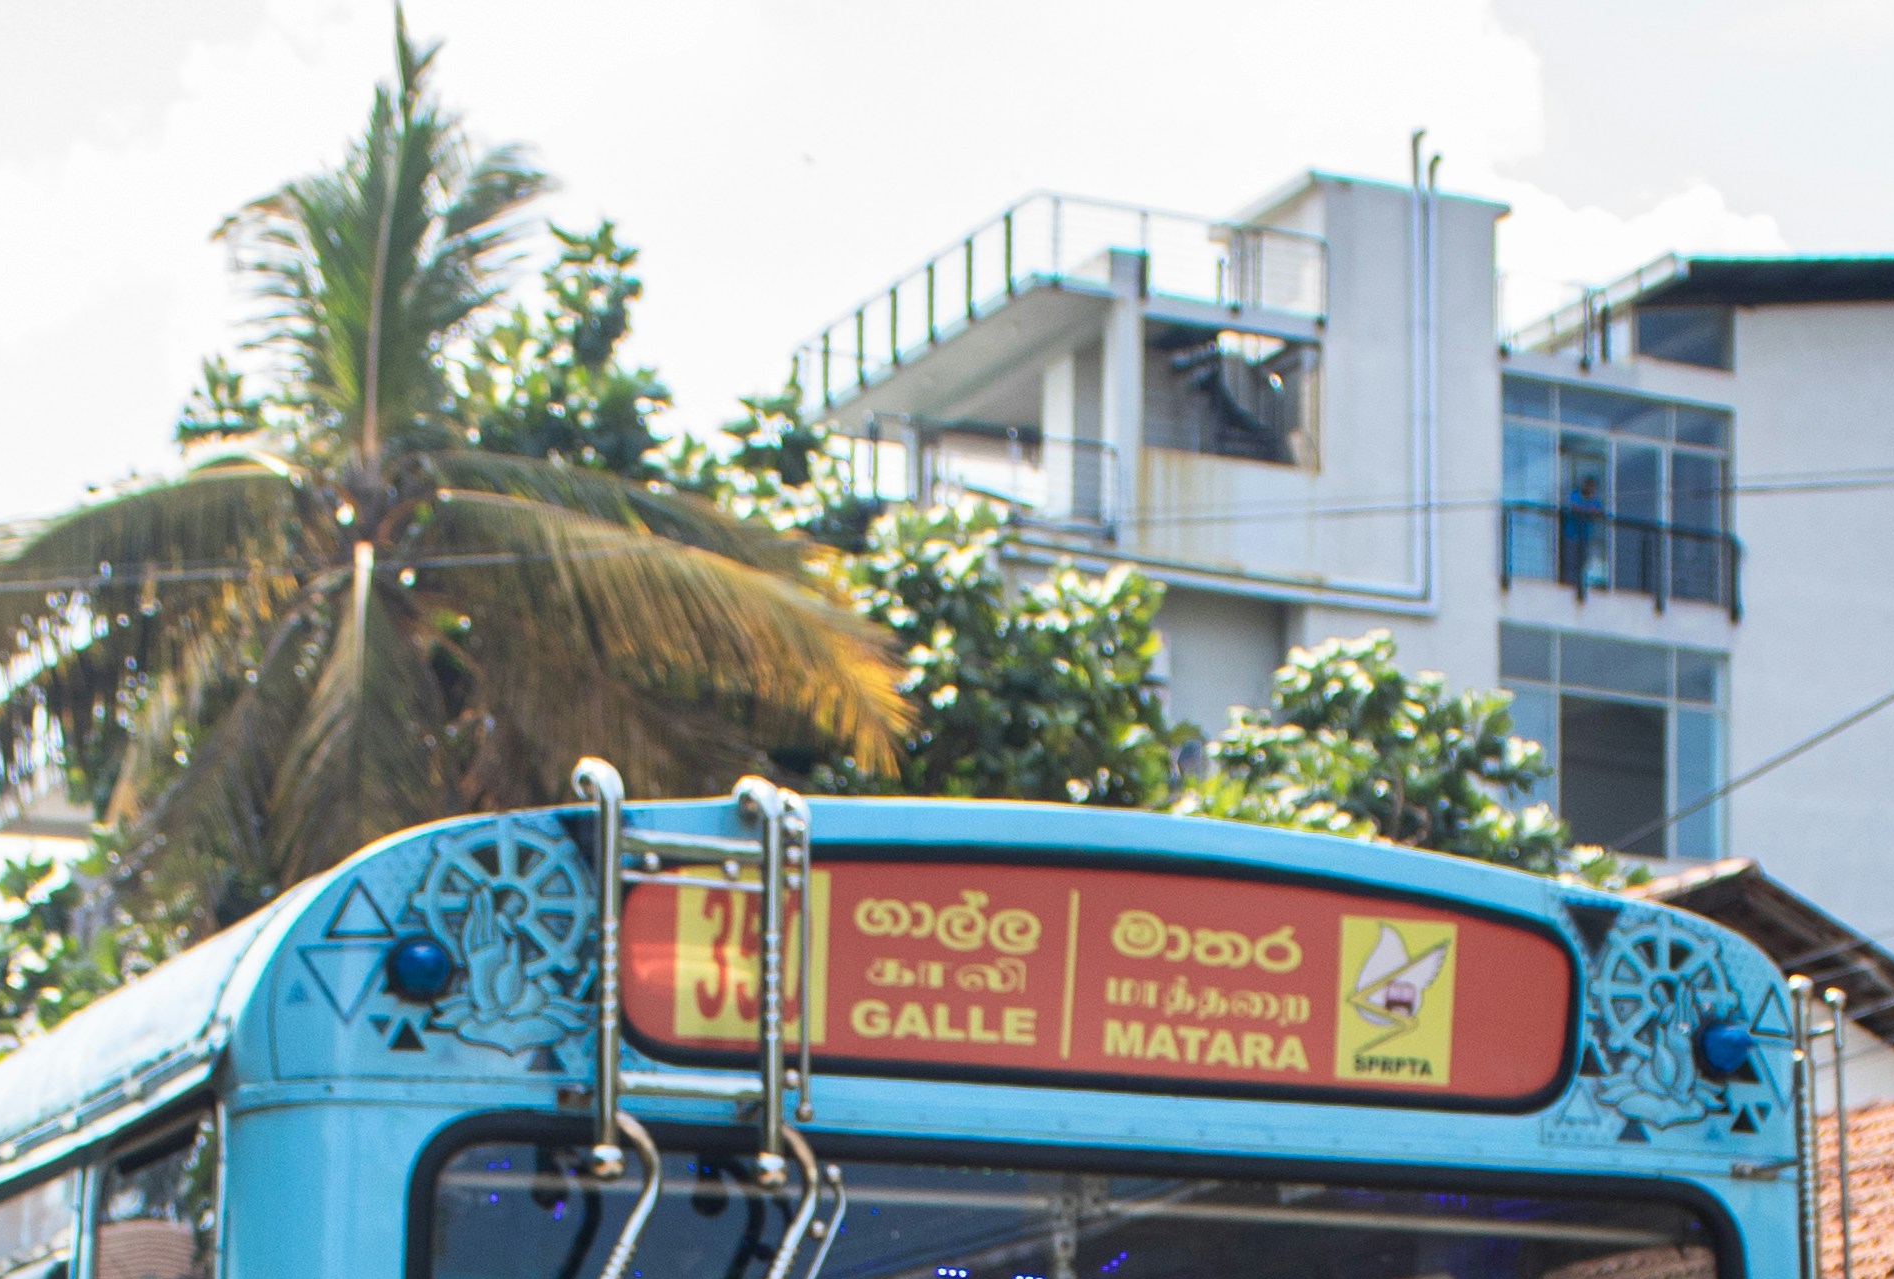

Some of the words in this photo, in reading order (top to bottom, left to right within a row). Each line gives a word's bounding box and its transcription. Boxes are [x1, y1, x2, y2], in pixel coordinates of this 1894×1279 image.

[854, 889, 1043, 955] ගාල්ල
[1110, 909, 1303, 974] මාතර
[865, 957, 1028, 994] காலி
[850, 999, 1038, 1046] GALLE
[1104, 1018, 1310, 1073] MATARA
[1353, 1053, 1433, 1078] SPRPTA
